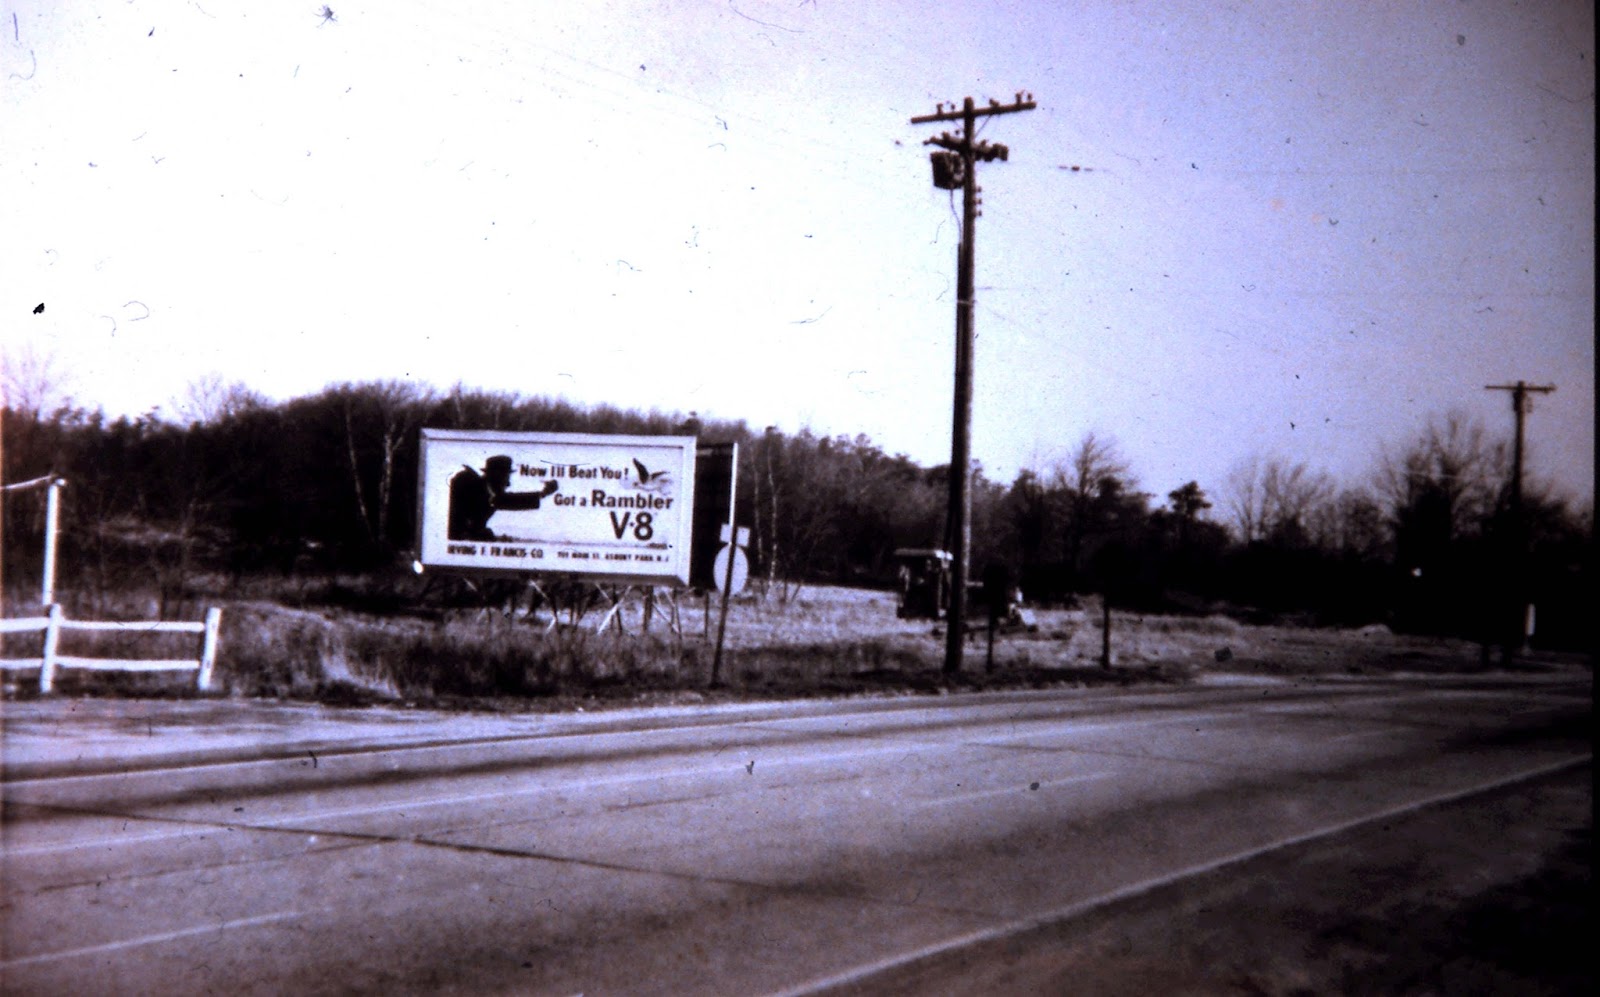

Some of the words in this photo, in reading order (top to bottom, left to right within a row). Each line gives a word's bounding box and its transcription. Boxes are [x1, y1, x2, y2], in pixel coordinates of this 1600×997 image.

[520, 463, 547, 477] Now
[569, 465, 598, 479] Beat
[554, 493, 576, 506] Got
[580, 497, 587, 507] a
[591, 489, 674, 510] Rambler
